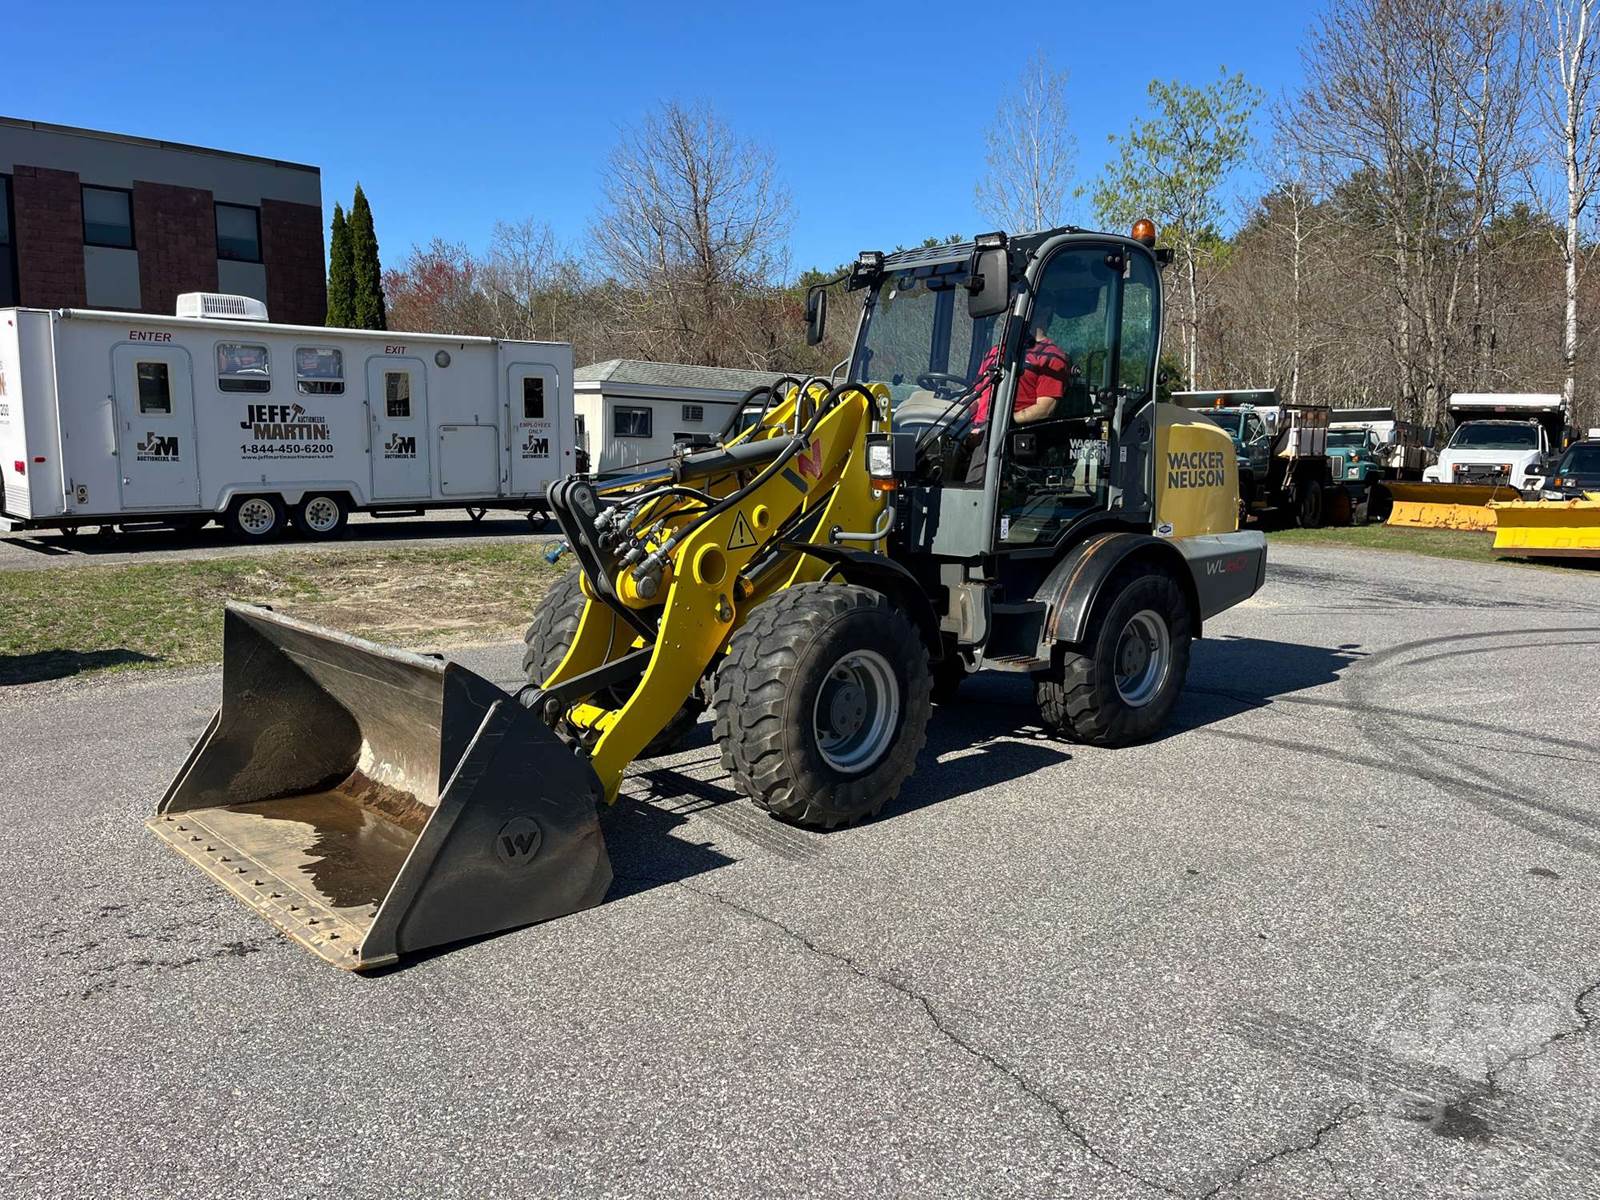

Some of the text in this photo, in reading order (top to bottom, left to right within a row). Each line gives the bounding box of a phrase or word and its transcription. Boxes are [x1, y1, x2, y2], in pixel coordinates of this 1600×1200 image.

[129, 330, 171, 342] ENTER
[385, 345, 407, 354] EXIT
[240, 404, 291, 429] JEFF
[253, 423, 326, 440] MARTIN
[240, 444, 334, 454] 1-844-450-6200
[1167, 451, 1225, 470] WACKER
[1167, 469, 1225, 489] NEUSON
[502, 831, 537, 857] W
